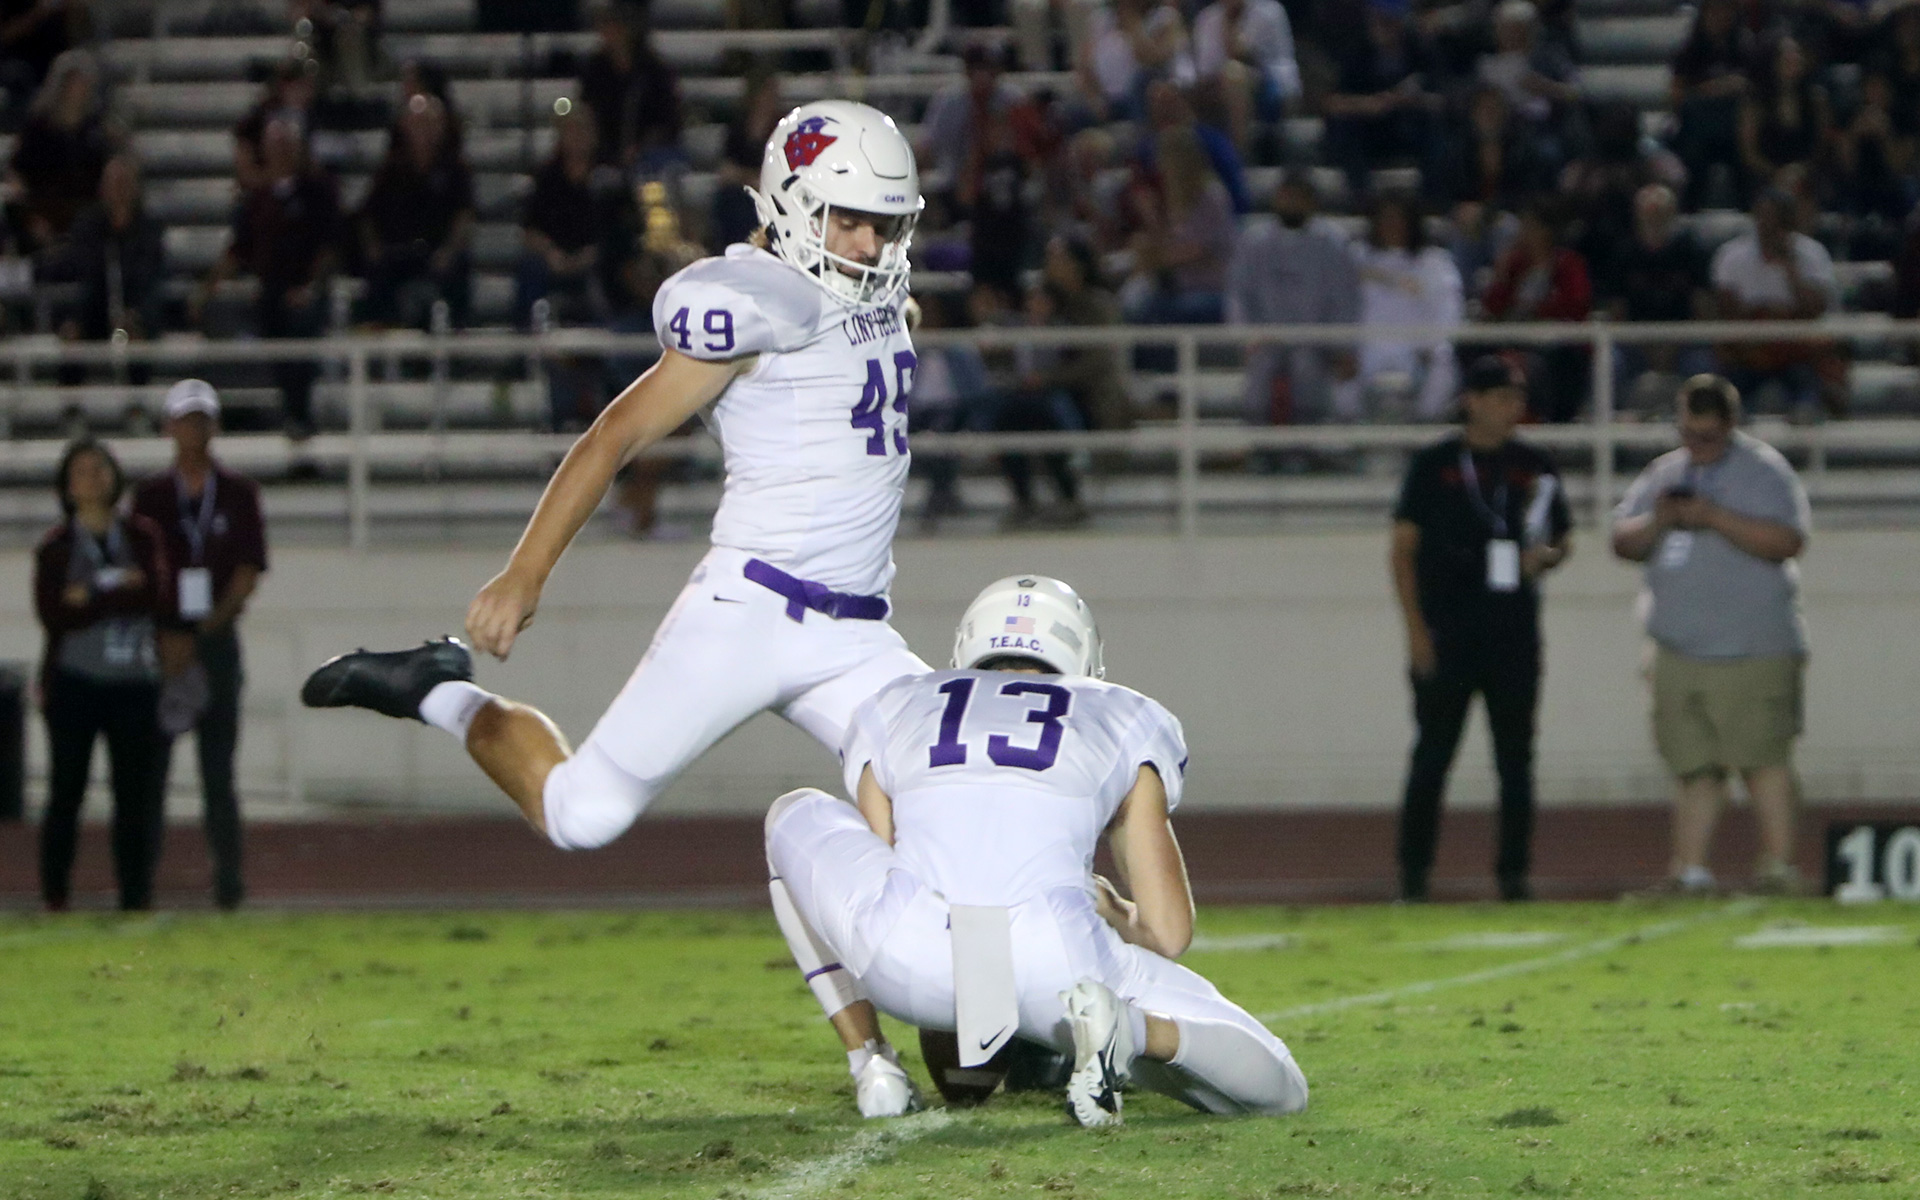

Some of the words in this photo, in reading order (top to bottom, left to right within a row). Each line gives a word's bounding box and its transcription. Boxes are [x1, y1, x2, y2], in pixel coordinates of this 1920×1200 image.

[670, 307, 735, 351] 49
[1017, 594, 1031, 607] 13
[989, 636, 1044, 653] T.E.A.C.
[929, 677, 1072, 772] 13
[1834, 826, 1920, 902] 10
